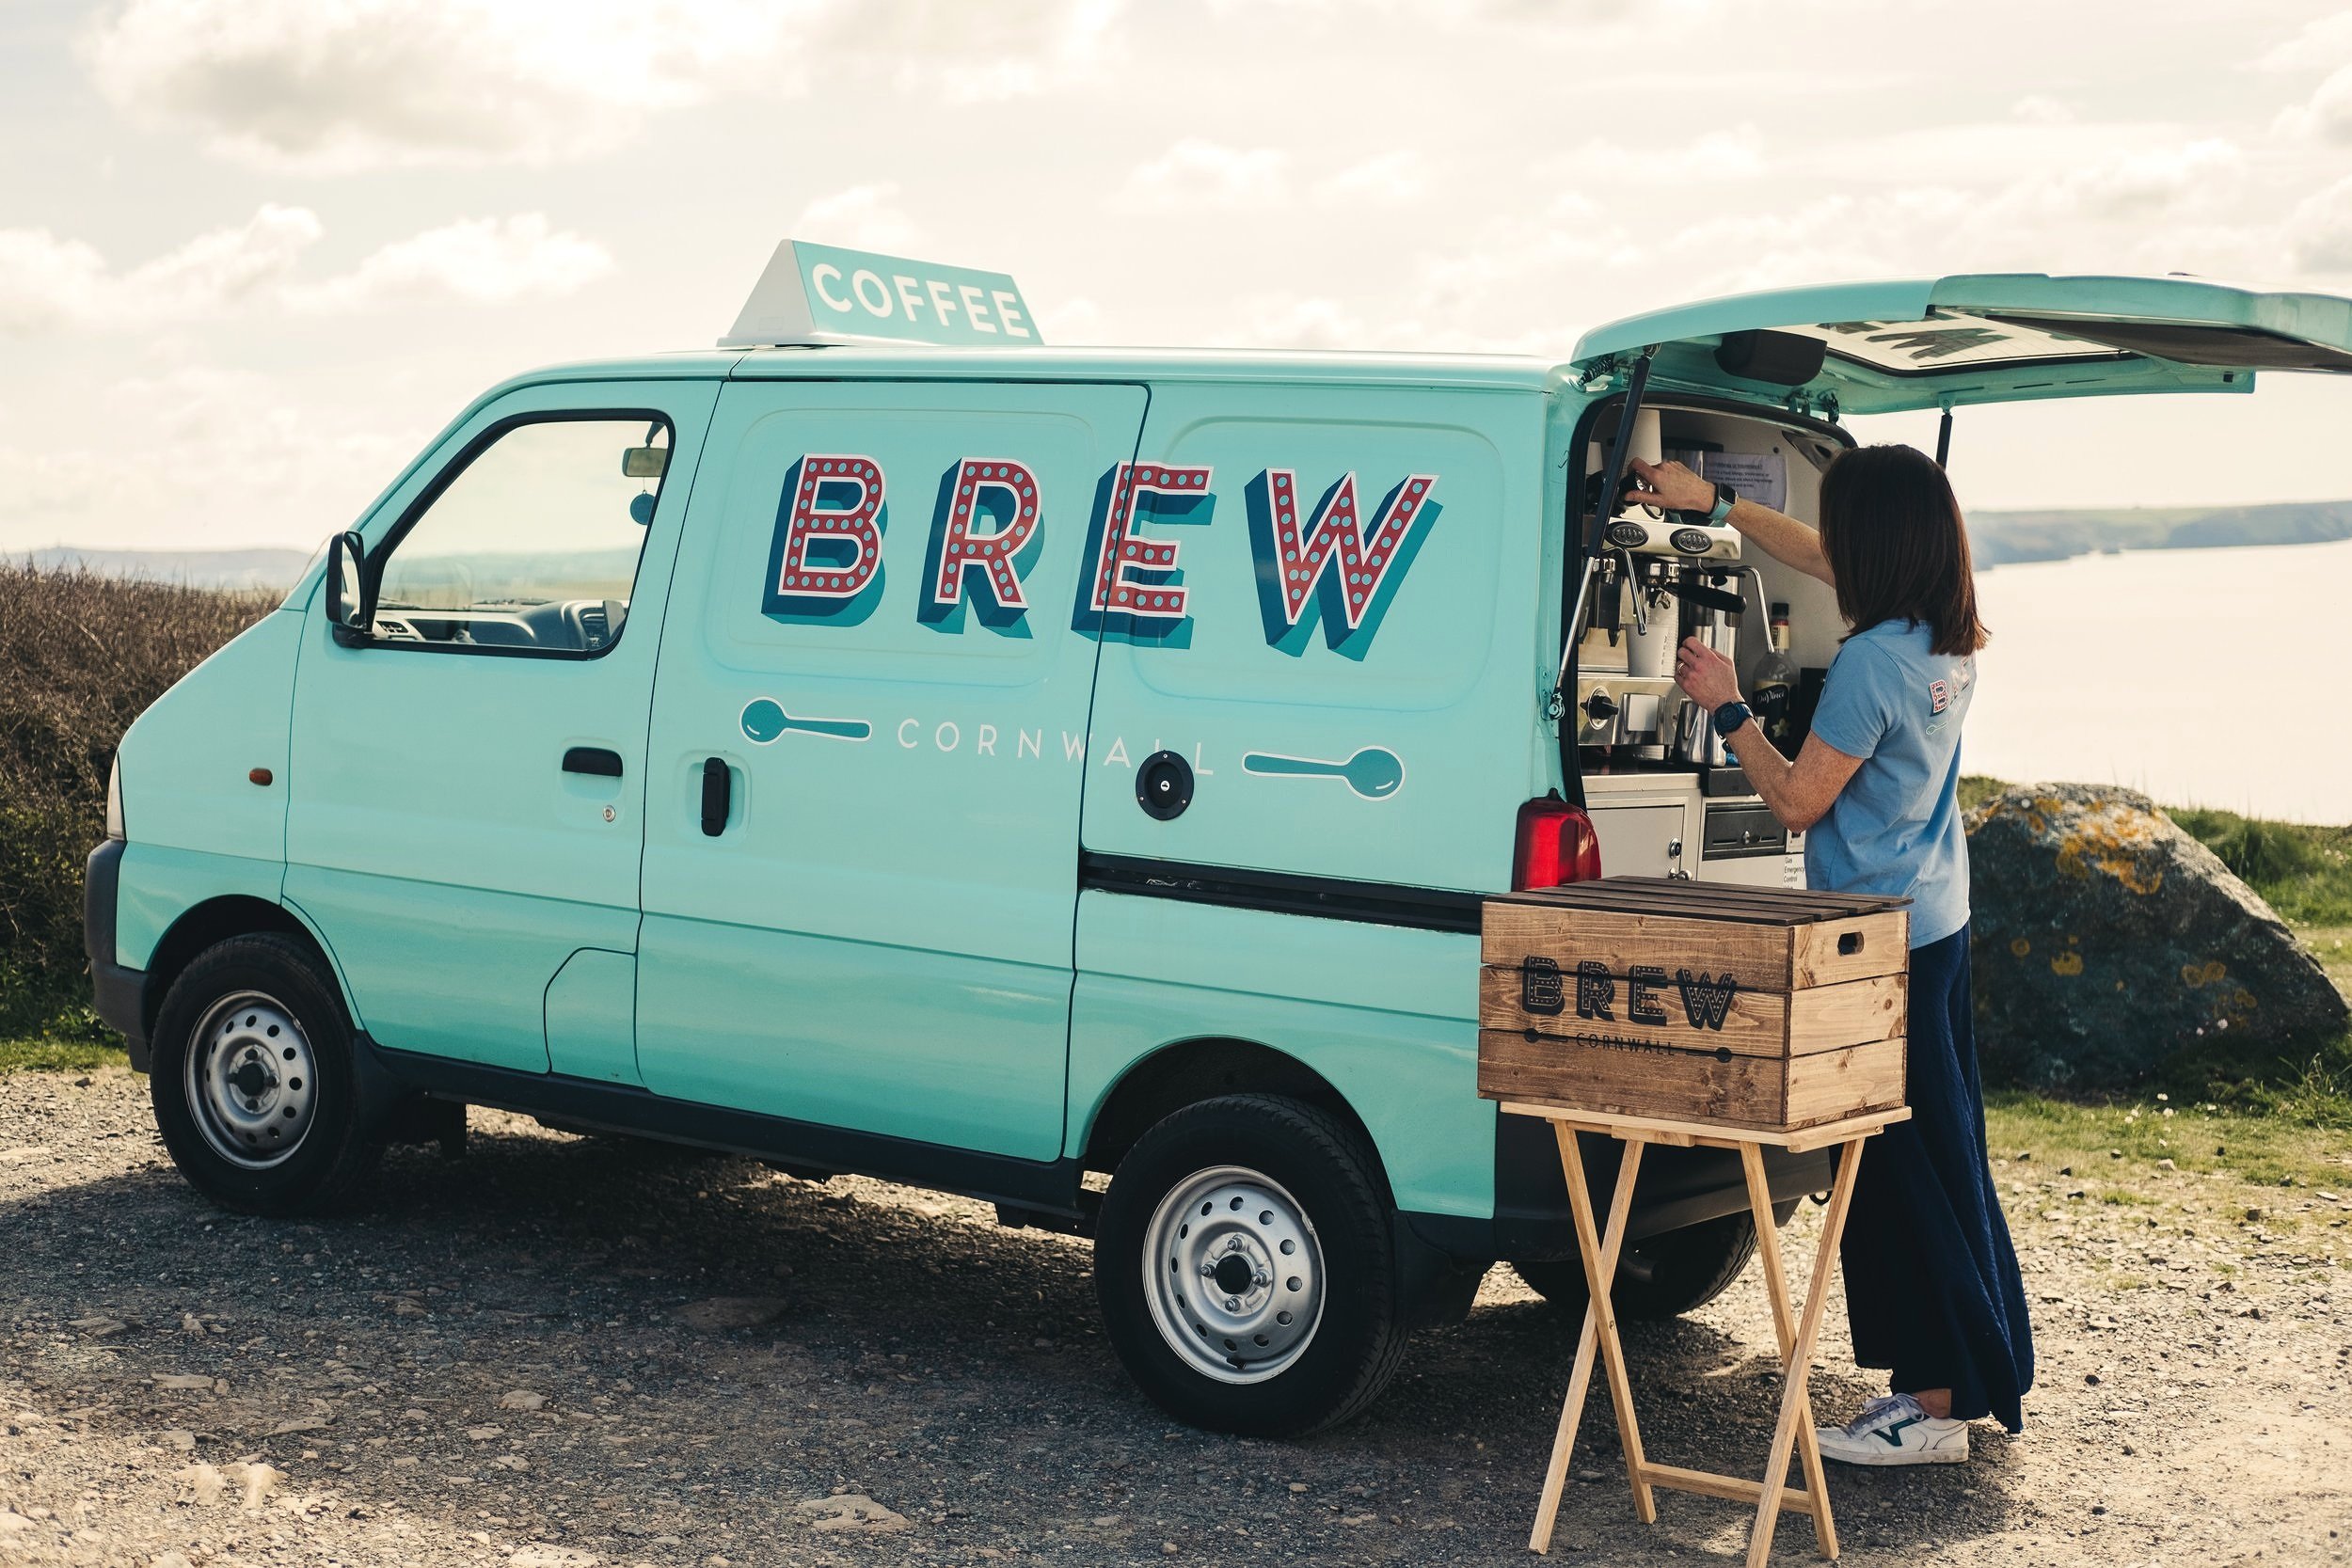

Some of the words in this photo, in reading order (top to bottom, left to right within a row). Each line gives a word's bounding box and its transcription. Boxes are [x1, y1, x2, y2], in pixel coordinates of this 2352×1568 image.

[812, 262, 1030, 338] COFFEE
[761, 453, 1443, 661] BREW
[1522, 955, 1738, 1031] BREW
[1576, 1032, 1675, 1056] CORNWALL
